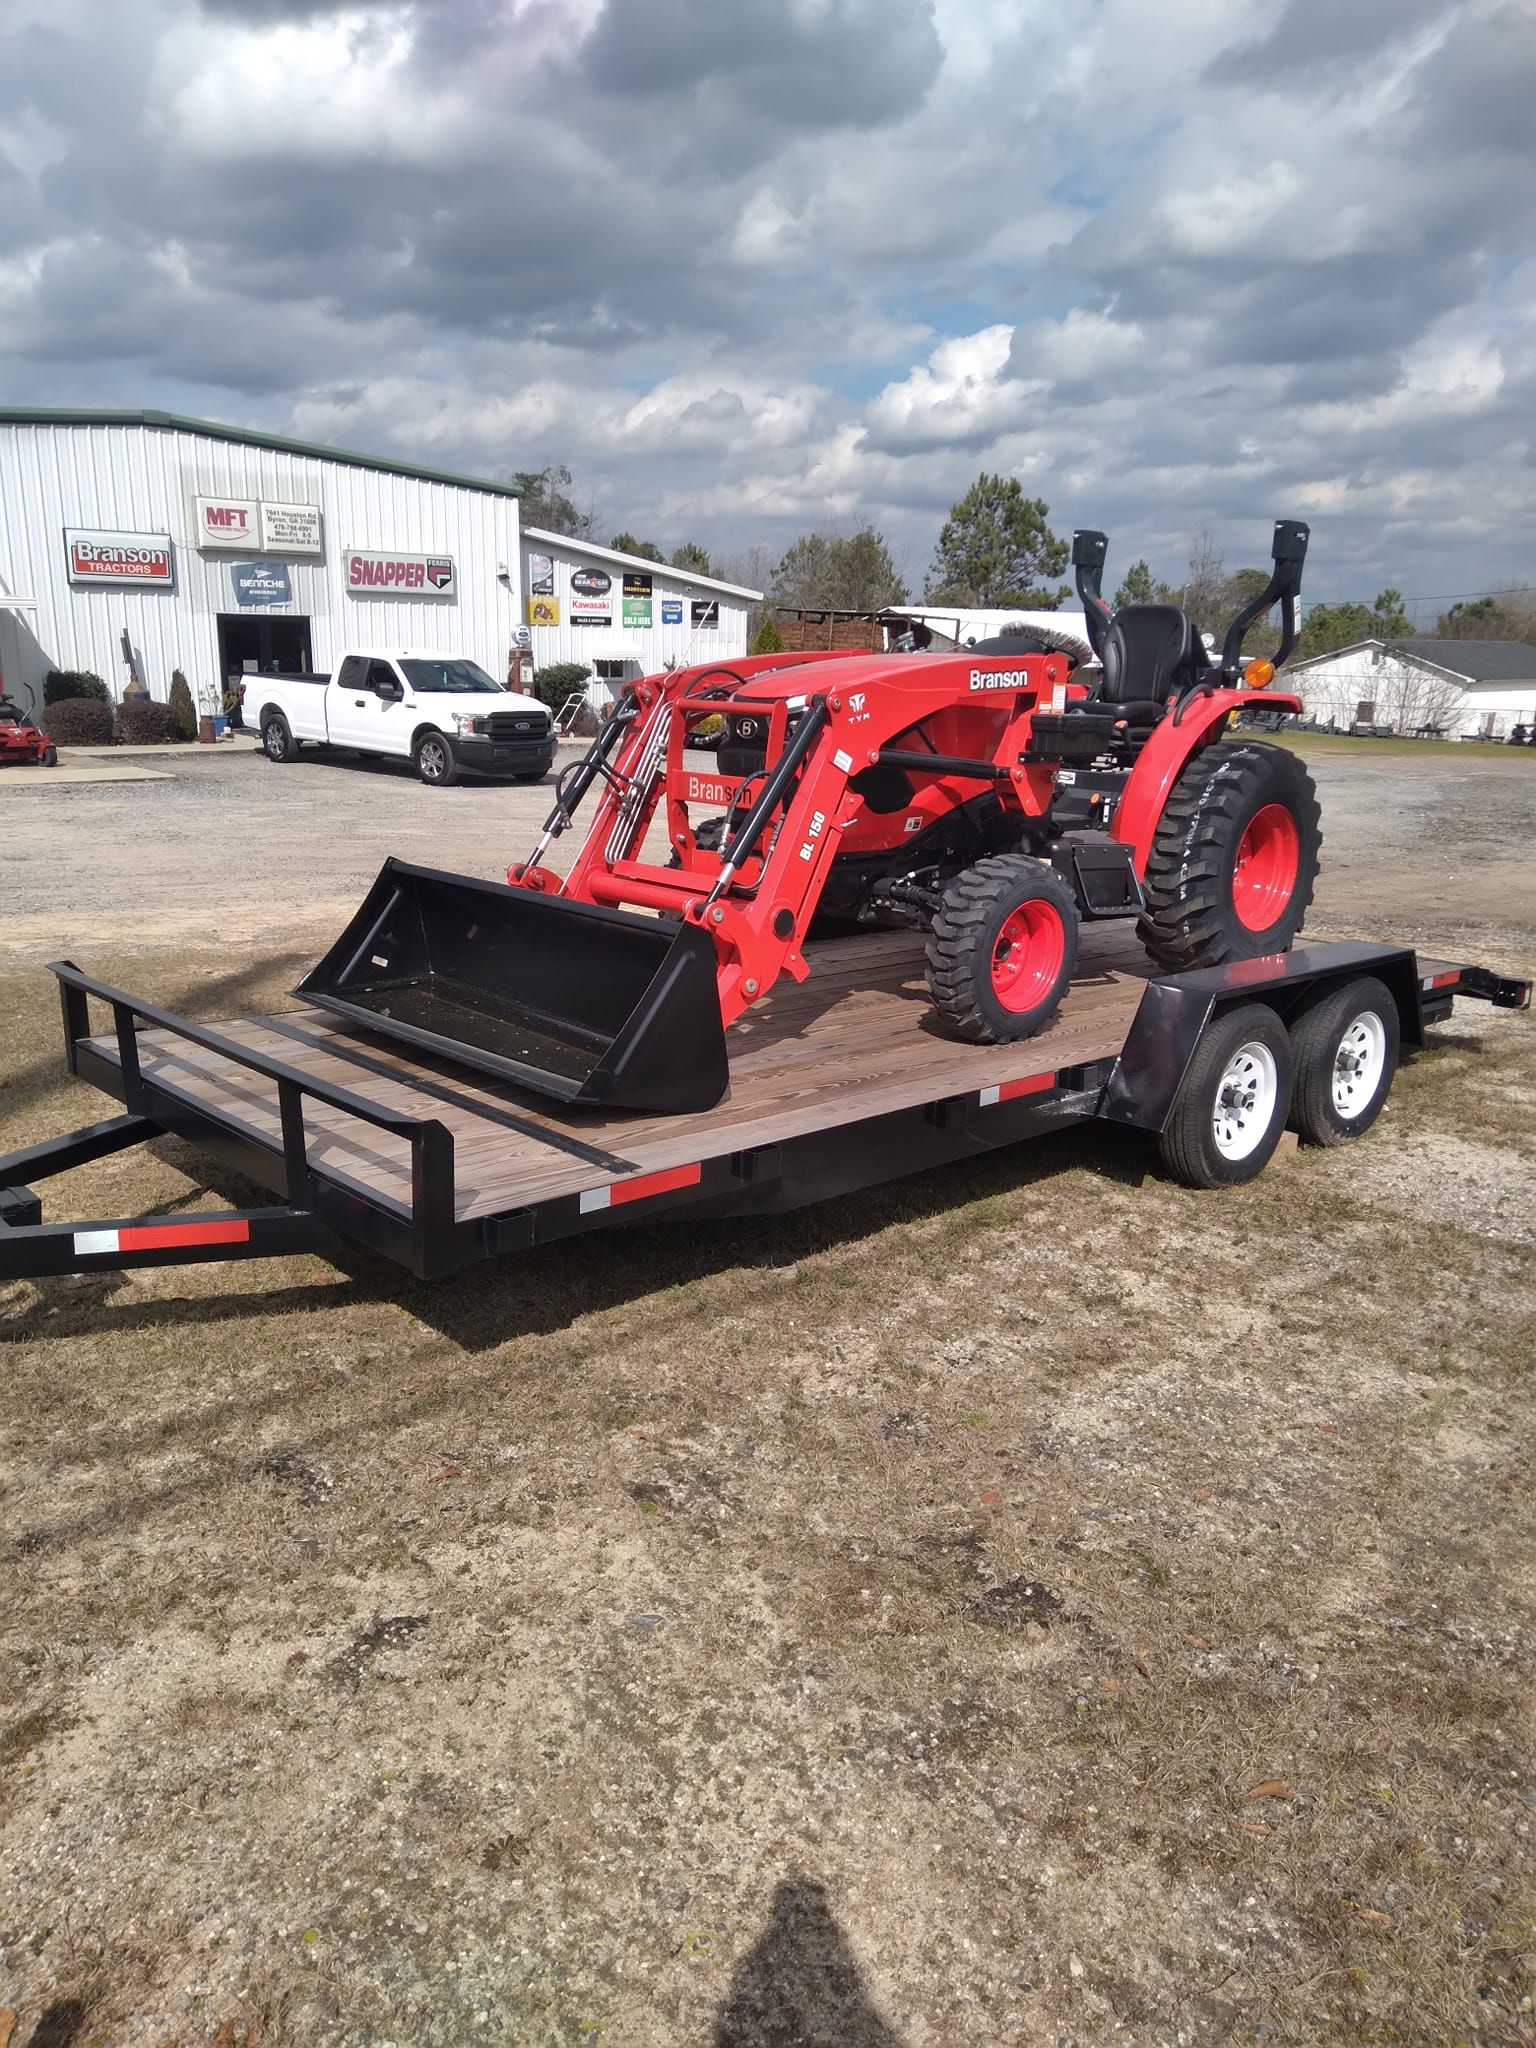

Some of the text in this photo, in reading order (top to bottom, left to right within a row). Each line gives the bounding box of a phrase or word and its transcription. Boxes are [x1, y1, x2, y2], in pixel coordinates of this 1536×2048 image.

[206, 507, 248, 527] MFT
[281, 510, 306, 518] Houston
[77, 541, 165, 564] Branson
[88, 562, 152, 574] TRACTORS
[350, 556, 425, 588] SNAPPER
[240, 579, 285, 588] BENNCHE
[572, 600, 609, 609] Kawasaki
[969, 669, 1028, 690] Branson
[848, 713, 870, 724] TYM
[742, 722, 751, 736] B
[689, 776, 752, 804] Branson
[799, 811, 826, 861] BL 150
